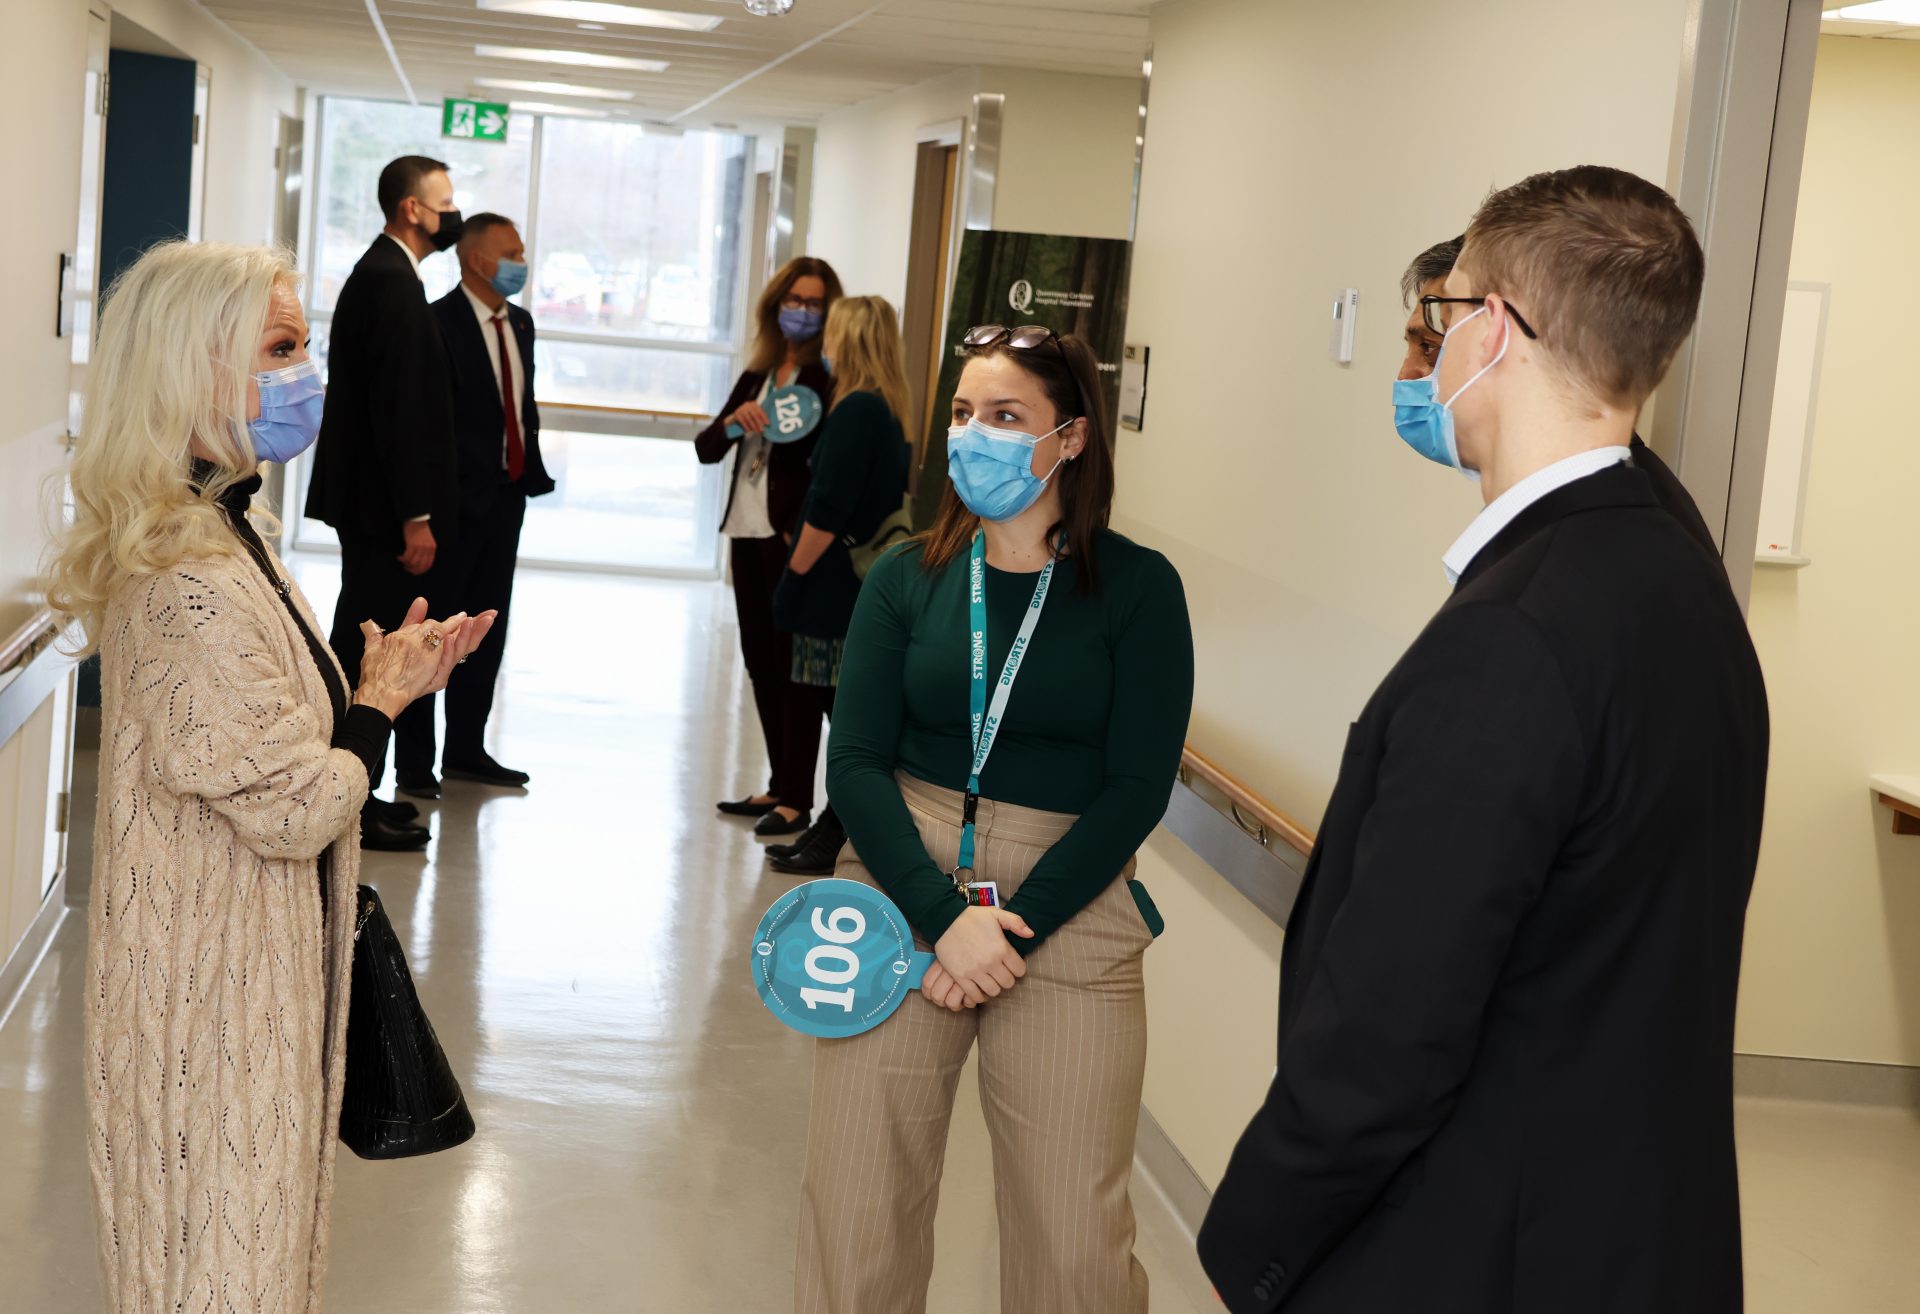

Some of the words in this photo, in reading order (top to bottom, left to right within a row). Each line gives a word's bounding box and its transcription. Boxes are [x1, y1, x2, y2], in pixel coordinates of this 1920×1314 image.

[775, 393, 803, 434] 126
[972, 557, 984, 604] STRONG
[973, 631, 985, 680] STRONG
[800, 906, 866, 1012] 106
